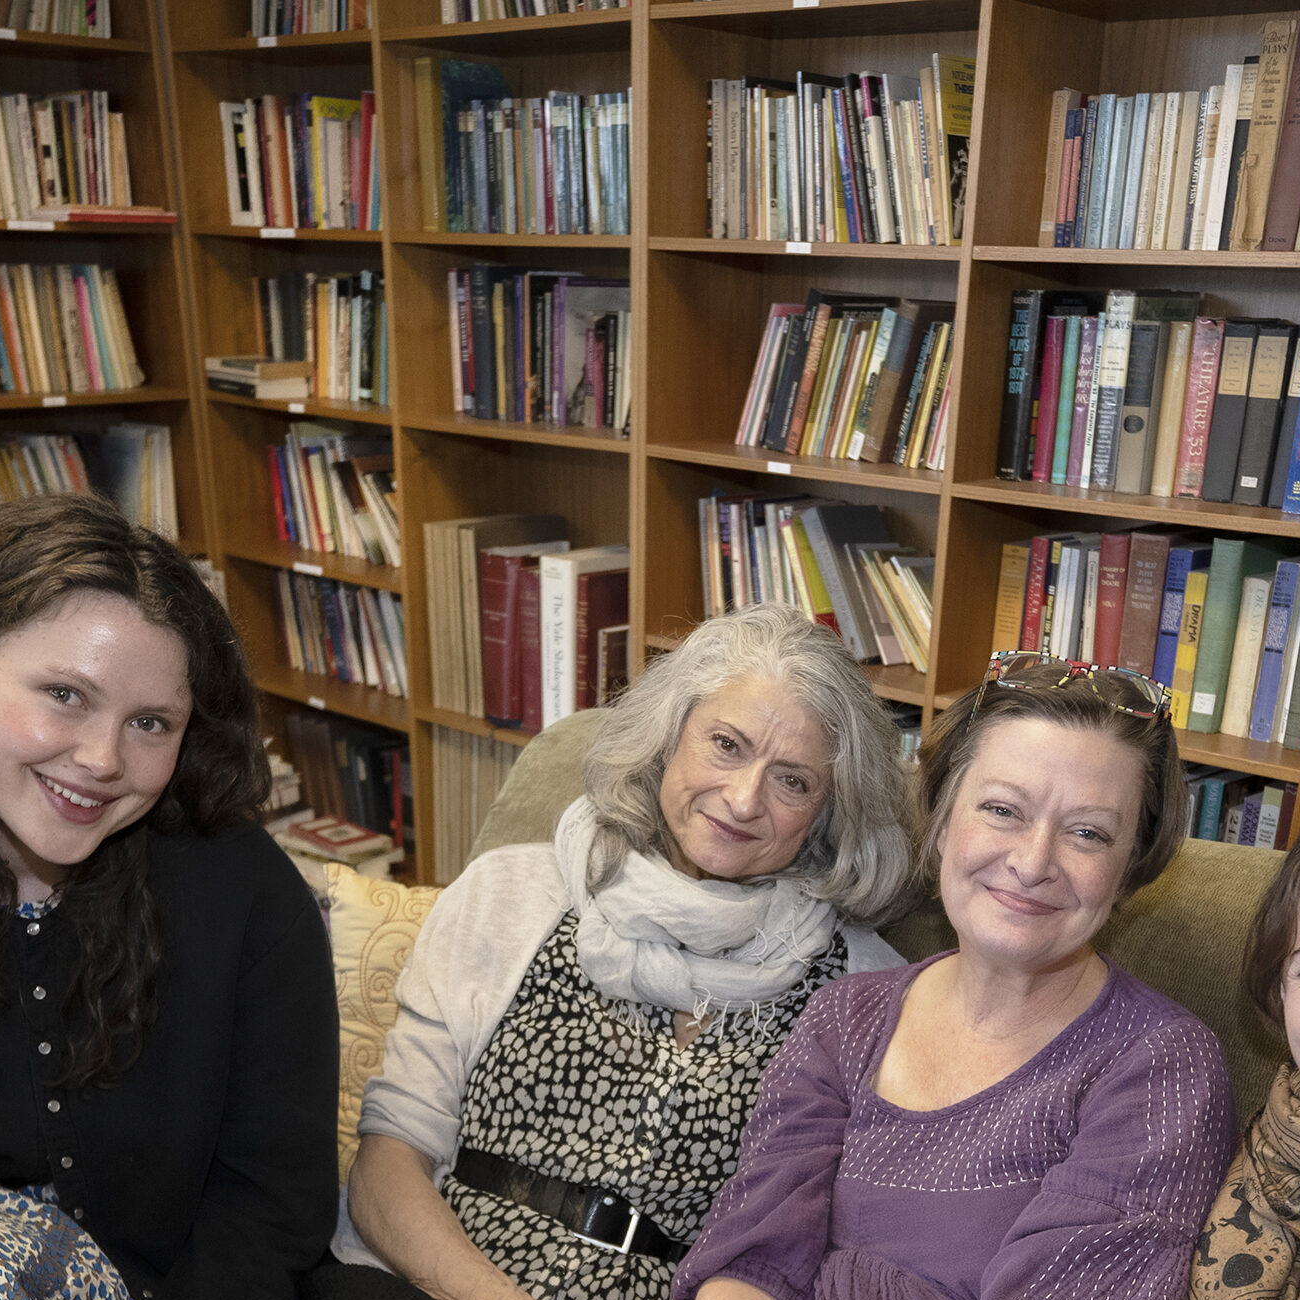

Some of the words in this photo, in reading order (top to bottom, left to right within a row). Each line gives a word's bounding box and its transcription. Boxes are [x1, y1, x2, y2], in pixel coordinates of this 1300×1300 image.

[1263, 43, 1288, 54] PLAYS
[729, 110, 742, 143] Seven
[728, 145, 741, 173] Plays
[1015, 309, 1029, 322] THE
[1104, 319, 1133, 331] PLAYS
[1011, 323, 1030, 337] BEST
[1008, 339, 1030, 353] PLAYS
[1012, 353, 1023, 366] OF
[1191, 351, 1217, 430] THEATRE
[1187, 433, 1204, 457] '53
[1033, 558, 1046, 588] TAKE
[552, 594, 563, 615] The
[1029, 593, 1041, 614] TEN
[553, 621, 564, 644] Yale
[1184, 603, 1204, 644] DRAMA
[550, 648, 566, 718] Shakespeare
[1241, 802, 1254, 842] DRAMA
[1251, 806, 1262, 843] WORLD
